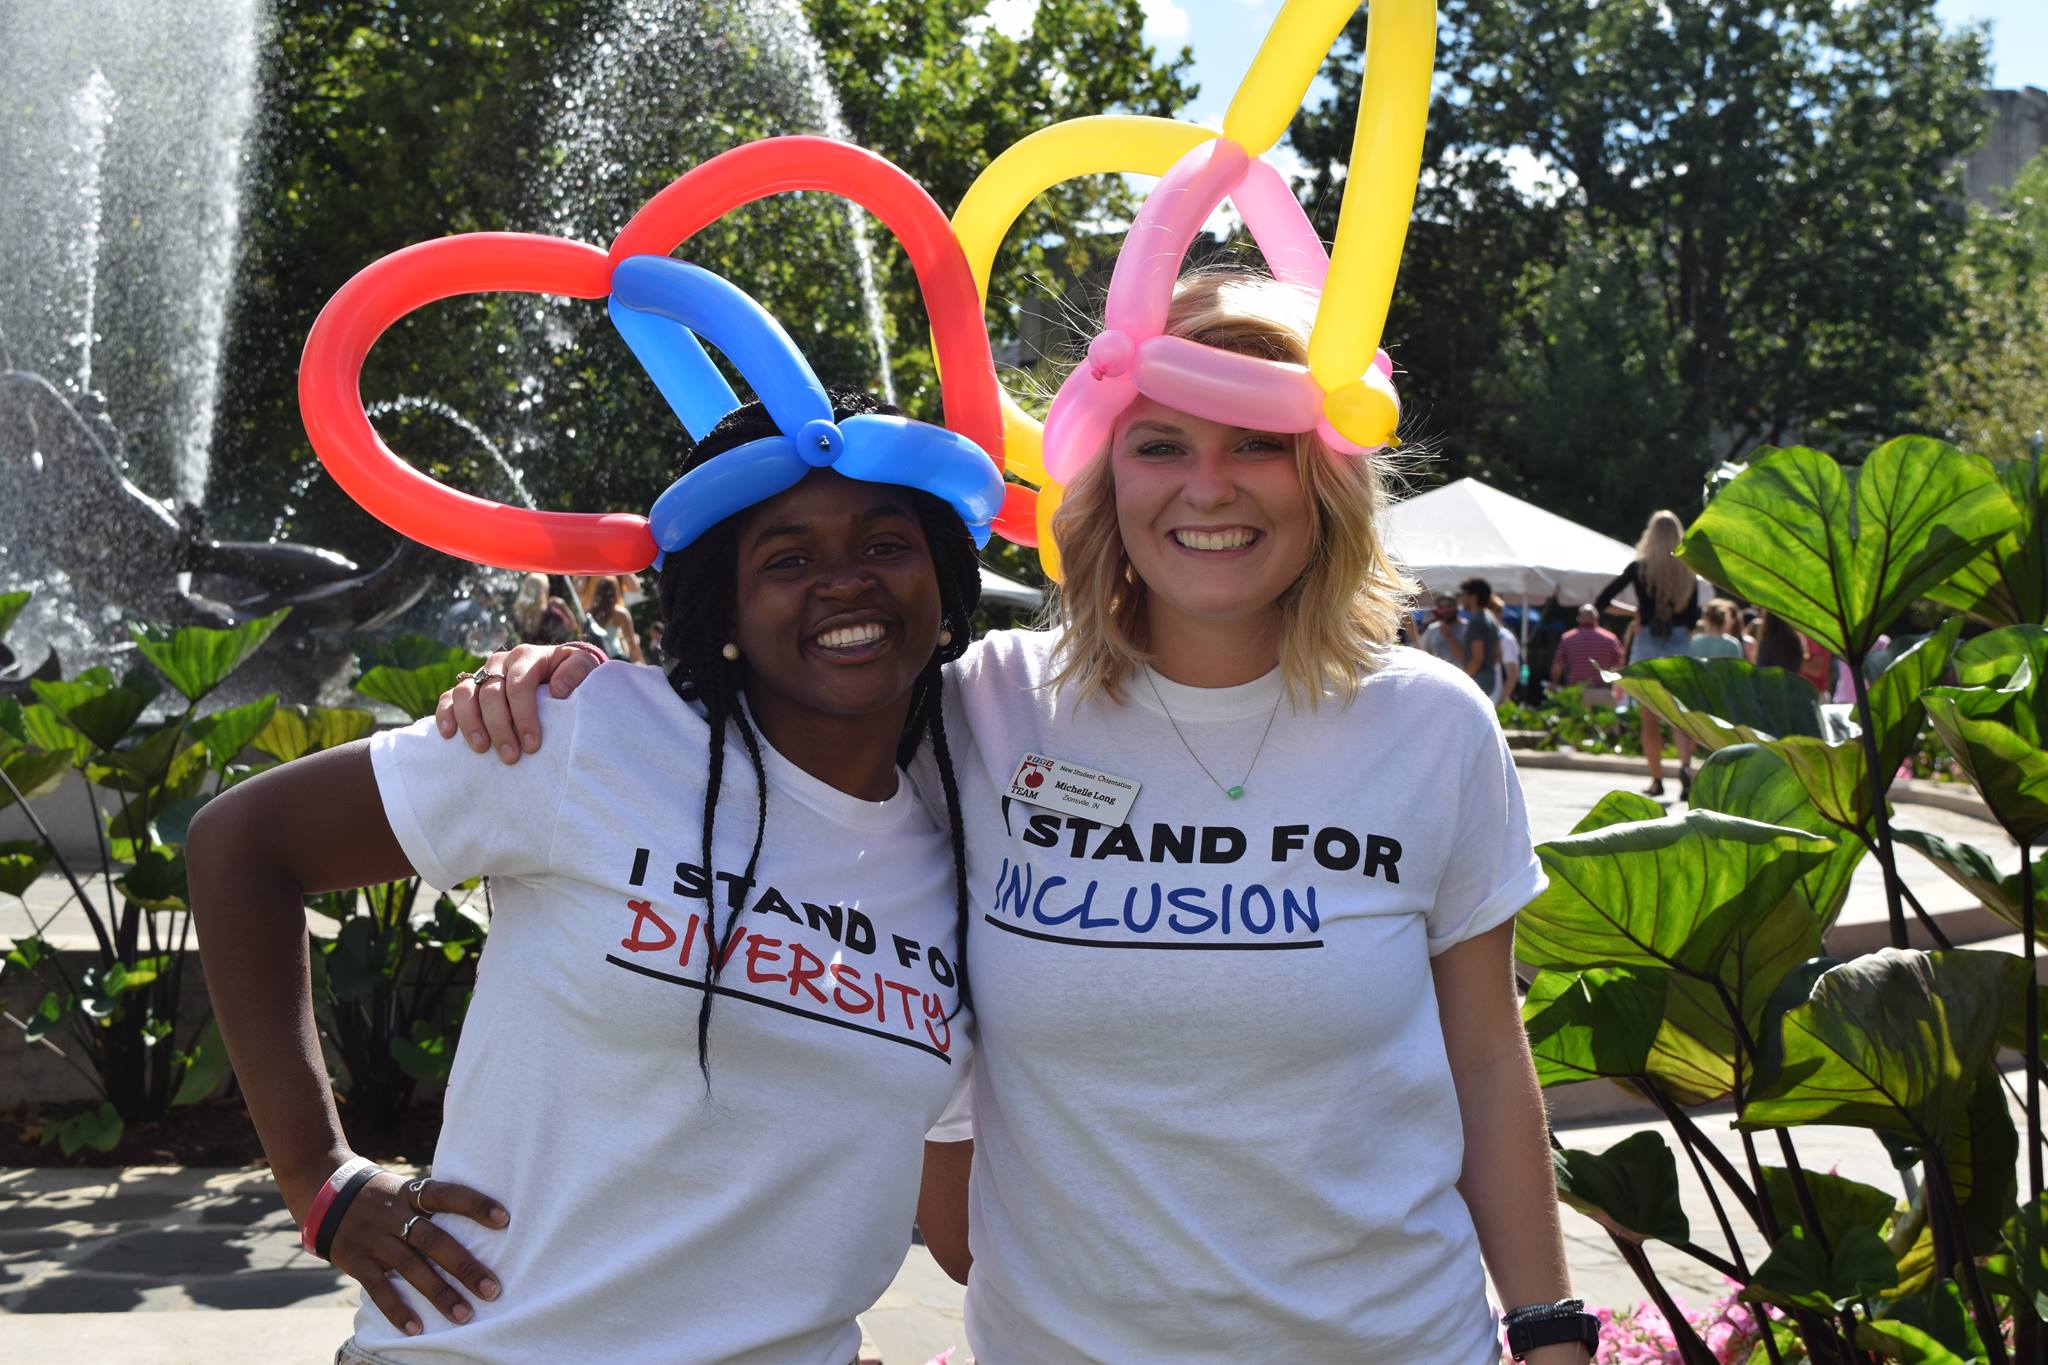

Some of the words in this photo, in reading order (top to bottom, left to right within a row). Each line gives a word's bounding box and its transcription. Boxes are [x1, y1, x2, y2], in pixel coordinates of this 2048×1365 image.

[1011, 785, 1039, 800] TEAM
[1054, 781, 1093, 798] Michelle
[1093, 791, 1117, 806] Long
[1059, 765, 1073, 774] New
[1072, 768, 1096, 780] Student
[1097, 774, 1132, 790] Orientation
[1091, 802, 1100, 810] IN
[1023, 814, 1248, 864] STAND
[1271, 824, 1403, 884] FOR
[629, 848, 650, 886] I
[673, 862, 877, 955] STAND
[892, 934, 961, 990] FO
[994, 857, 1320, 935] INCLUSION
[621, 899, 951, 1054] DIVERSITY
